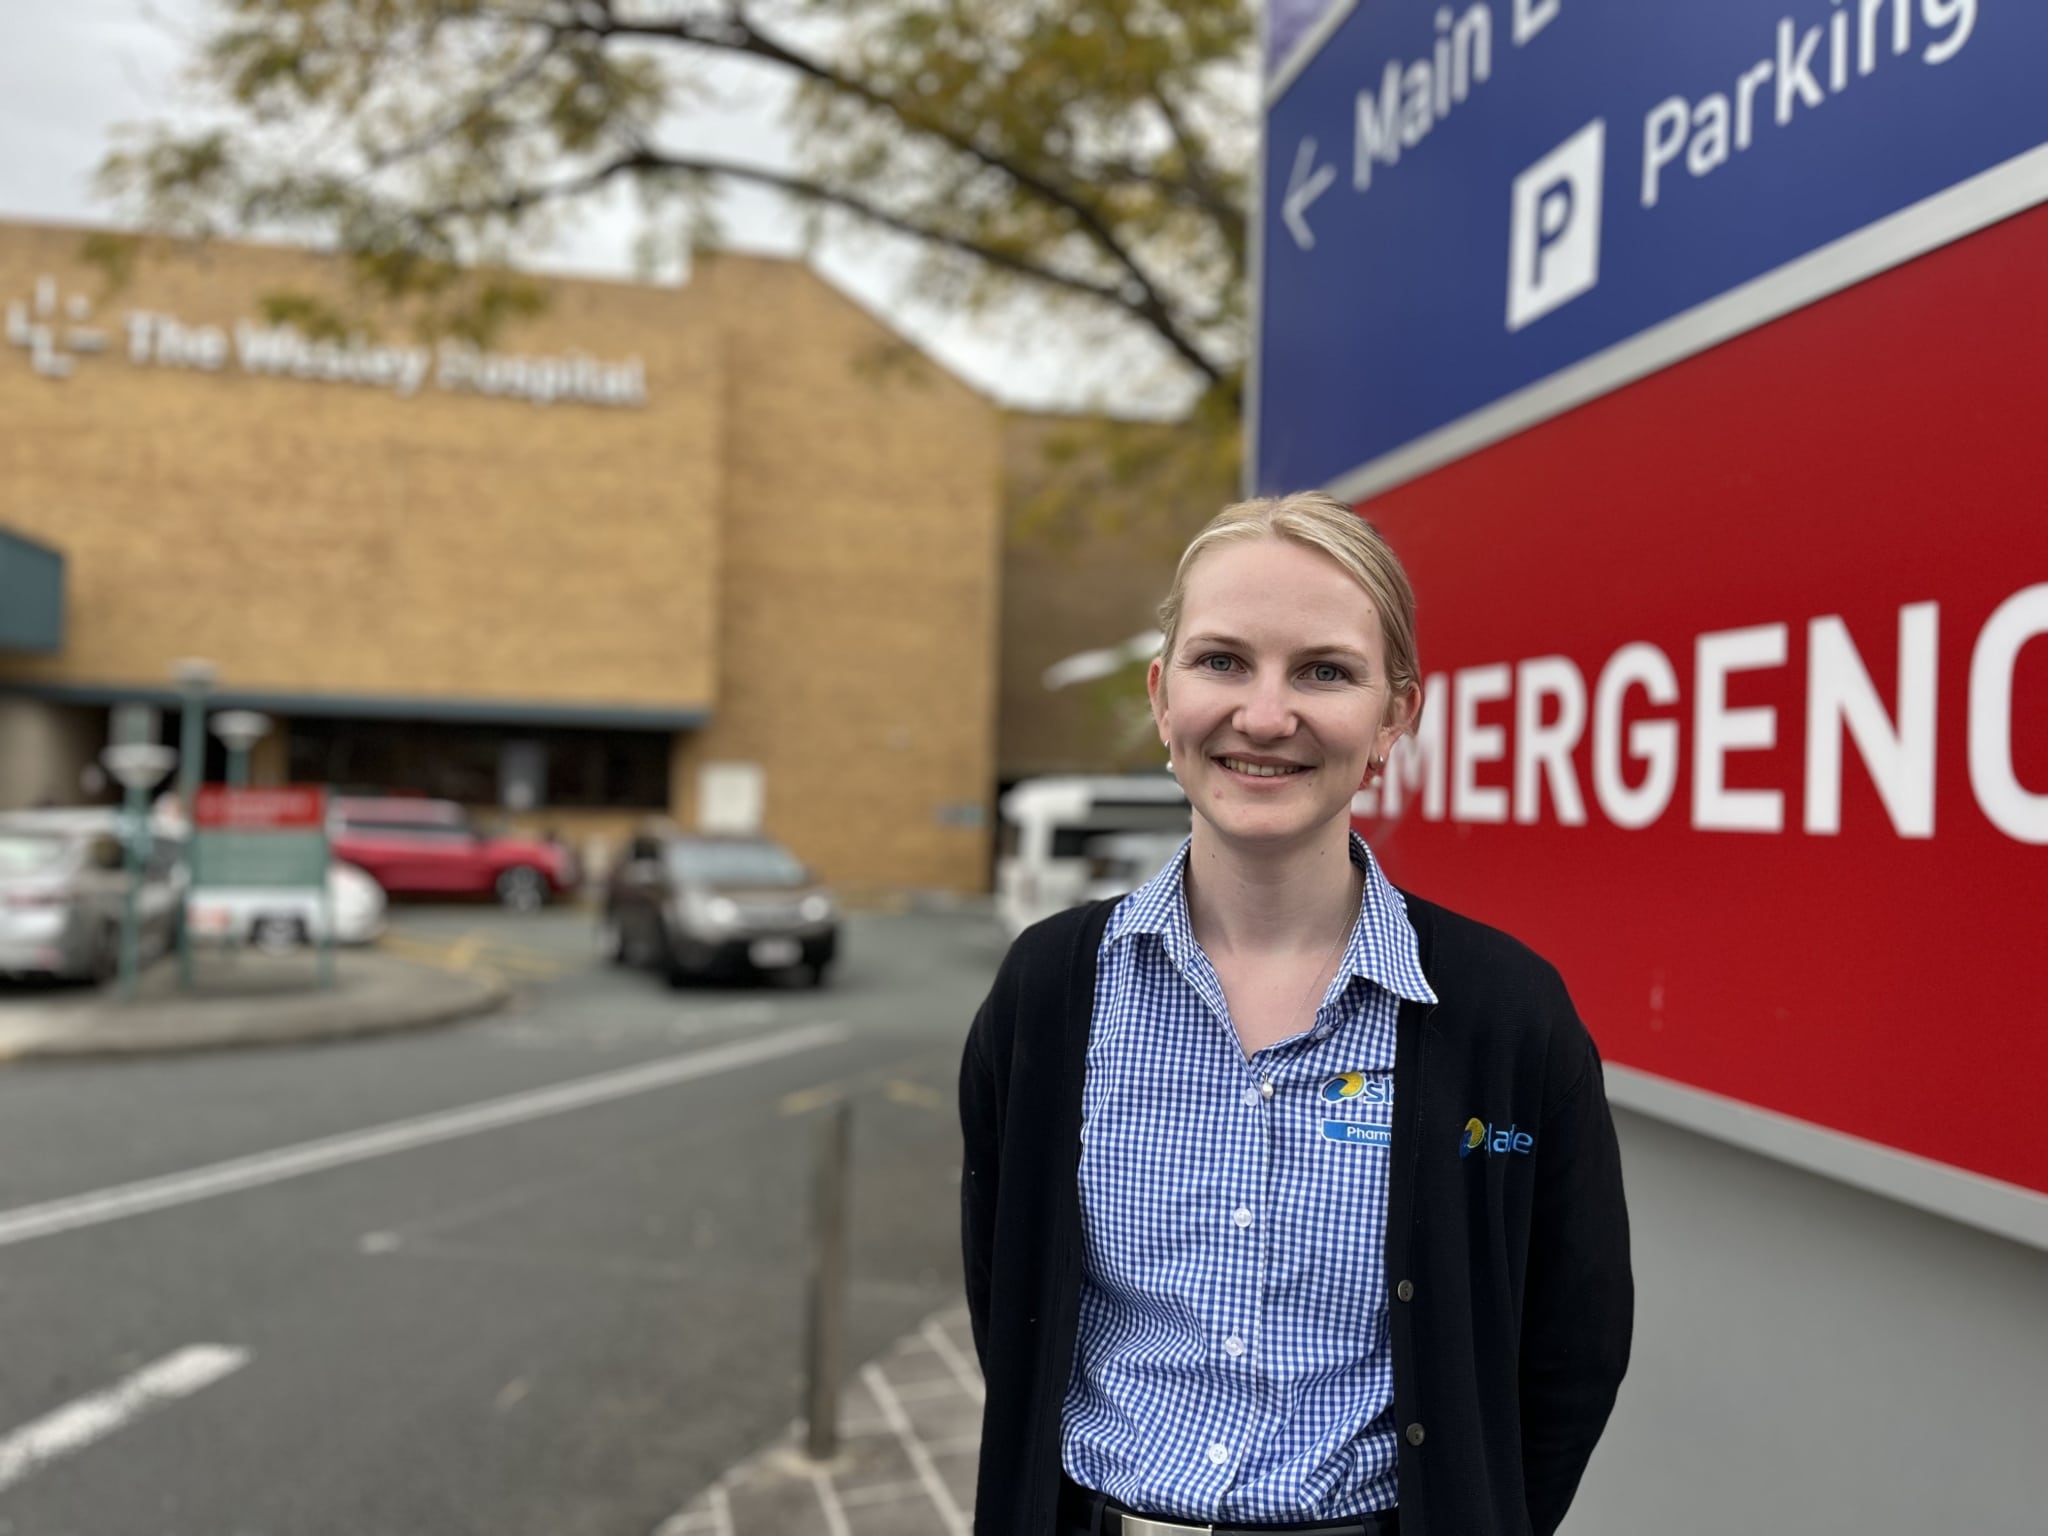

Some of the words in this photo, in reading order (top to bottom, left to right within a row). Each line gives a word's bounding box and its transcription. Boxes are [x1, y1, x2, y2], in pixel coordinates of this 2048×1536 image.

[1354, 2, 1492, 192] Main
[1531, 174, 1576, 290] P
[125, 310, 228, 369] The
[1350, 582, 2048, 846] MERGENC
